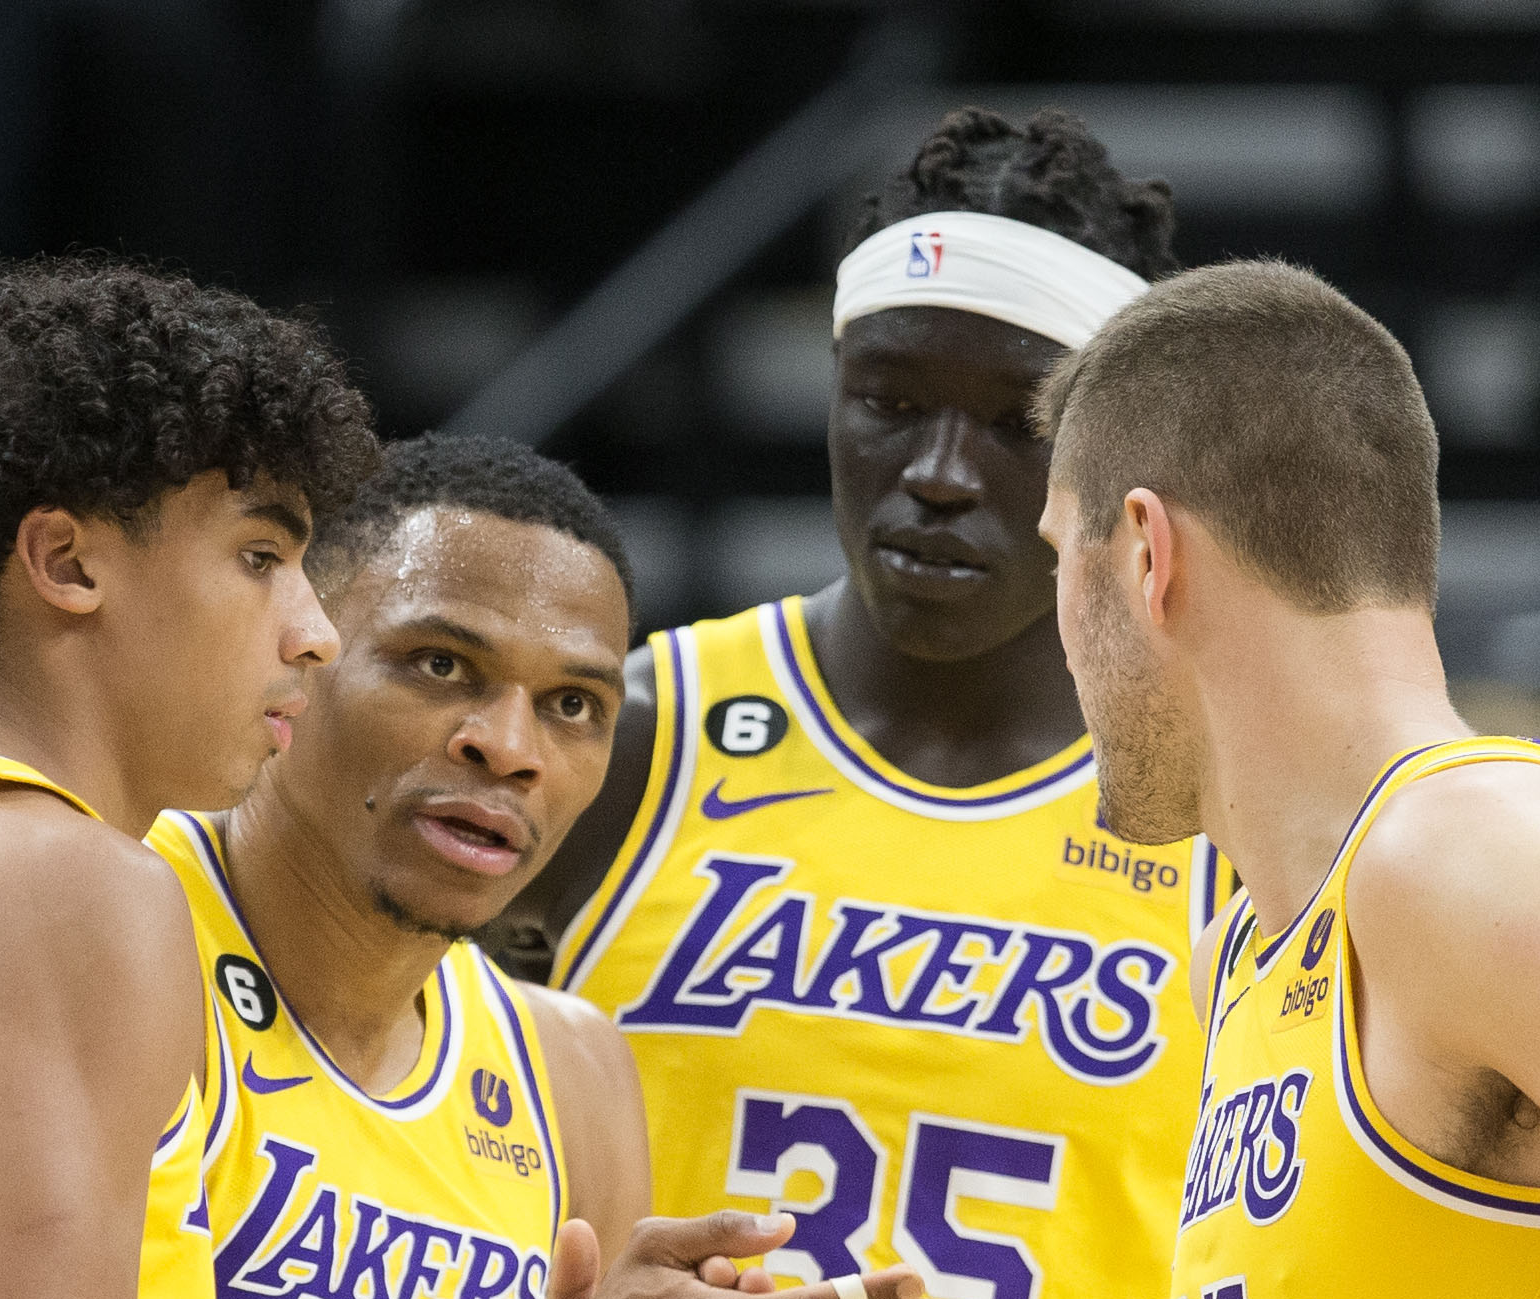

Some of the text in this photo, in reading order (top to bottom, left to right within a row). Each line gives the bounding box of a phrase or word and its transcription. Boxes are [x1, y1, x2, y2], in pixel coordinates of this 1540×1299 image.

[721, 701, 770, 752] 6
[1061, 837, 1180, 892] bibigo
[224, 963, 264, 1024] 6
[615, 850, 1177, 1086] LAKERS
[1279, 974, 1330, 1018] bibigo
[464, 1126, 543, 1178] bibigo
[1178, 1066, 1315, 1237] AKERS
